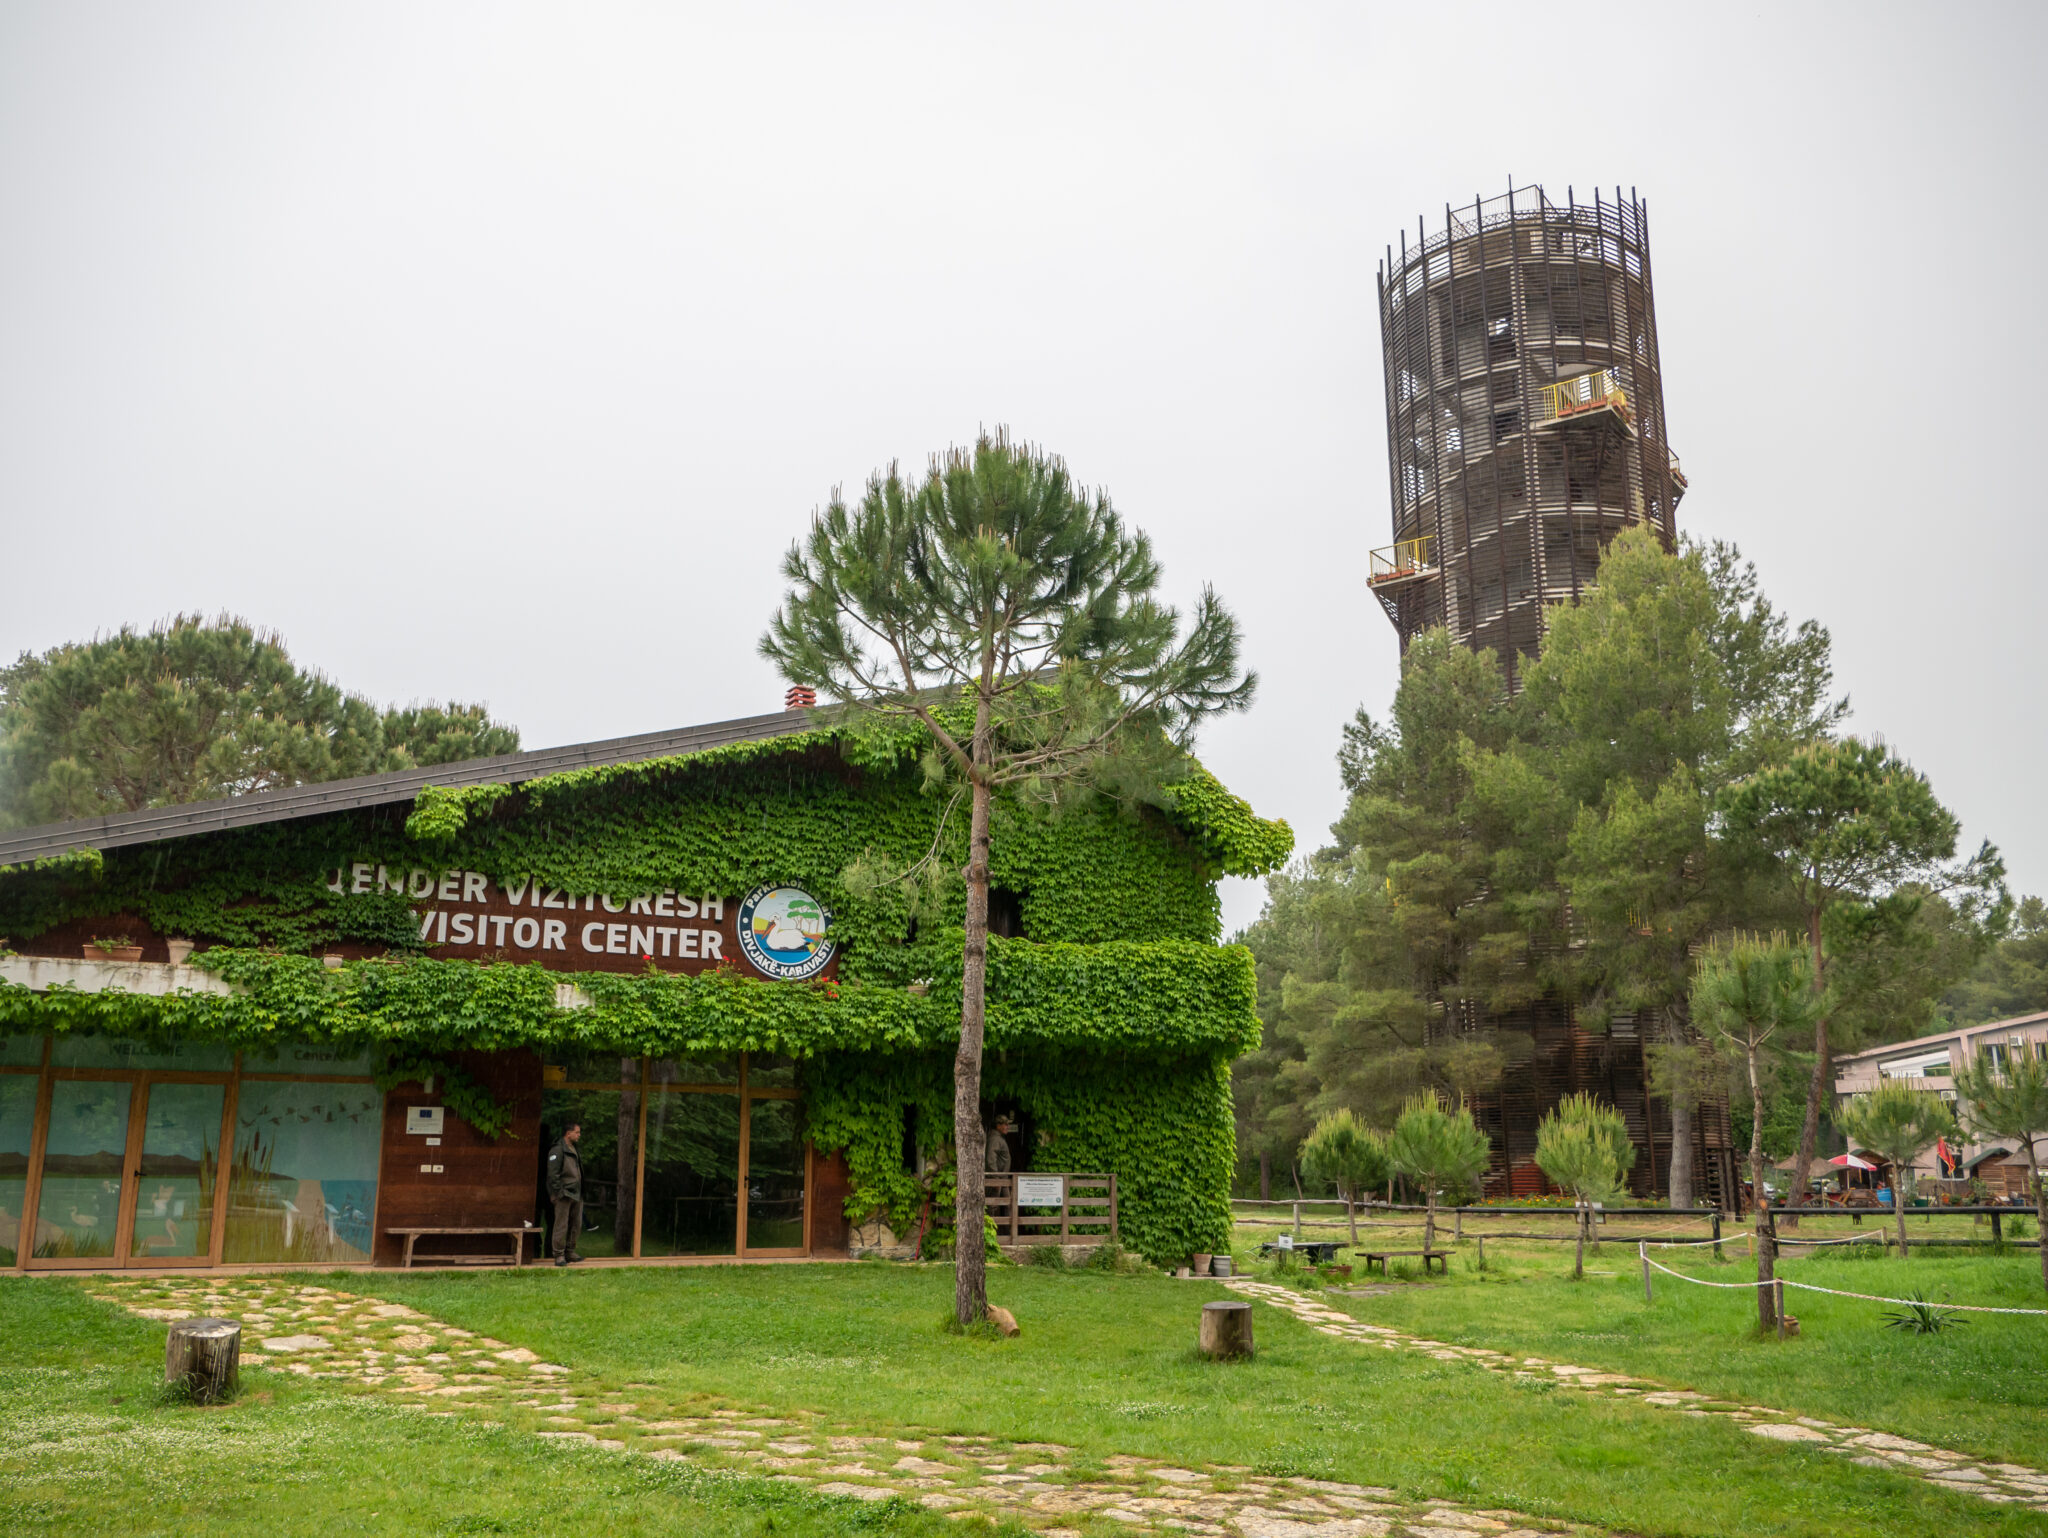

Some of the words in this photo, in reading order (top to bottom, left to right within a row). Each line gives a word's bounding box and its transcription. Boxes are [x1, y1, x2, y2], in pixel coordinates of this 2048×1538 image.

[745, 881, 778, 909] Parku
[410, 910, 566, 950] VISITOR
[582, 922, 723, 960] CENTER
[109, 1043, 184, 1057] WELCOME
